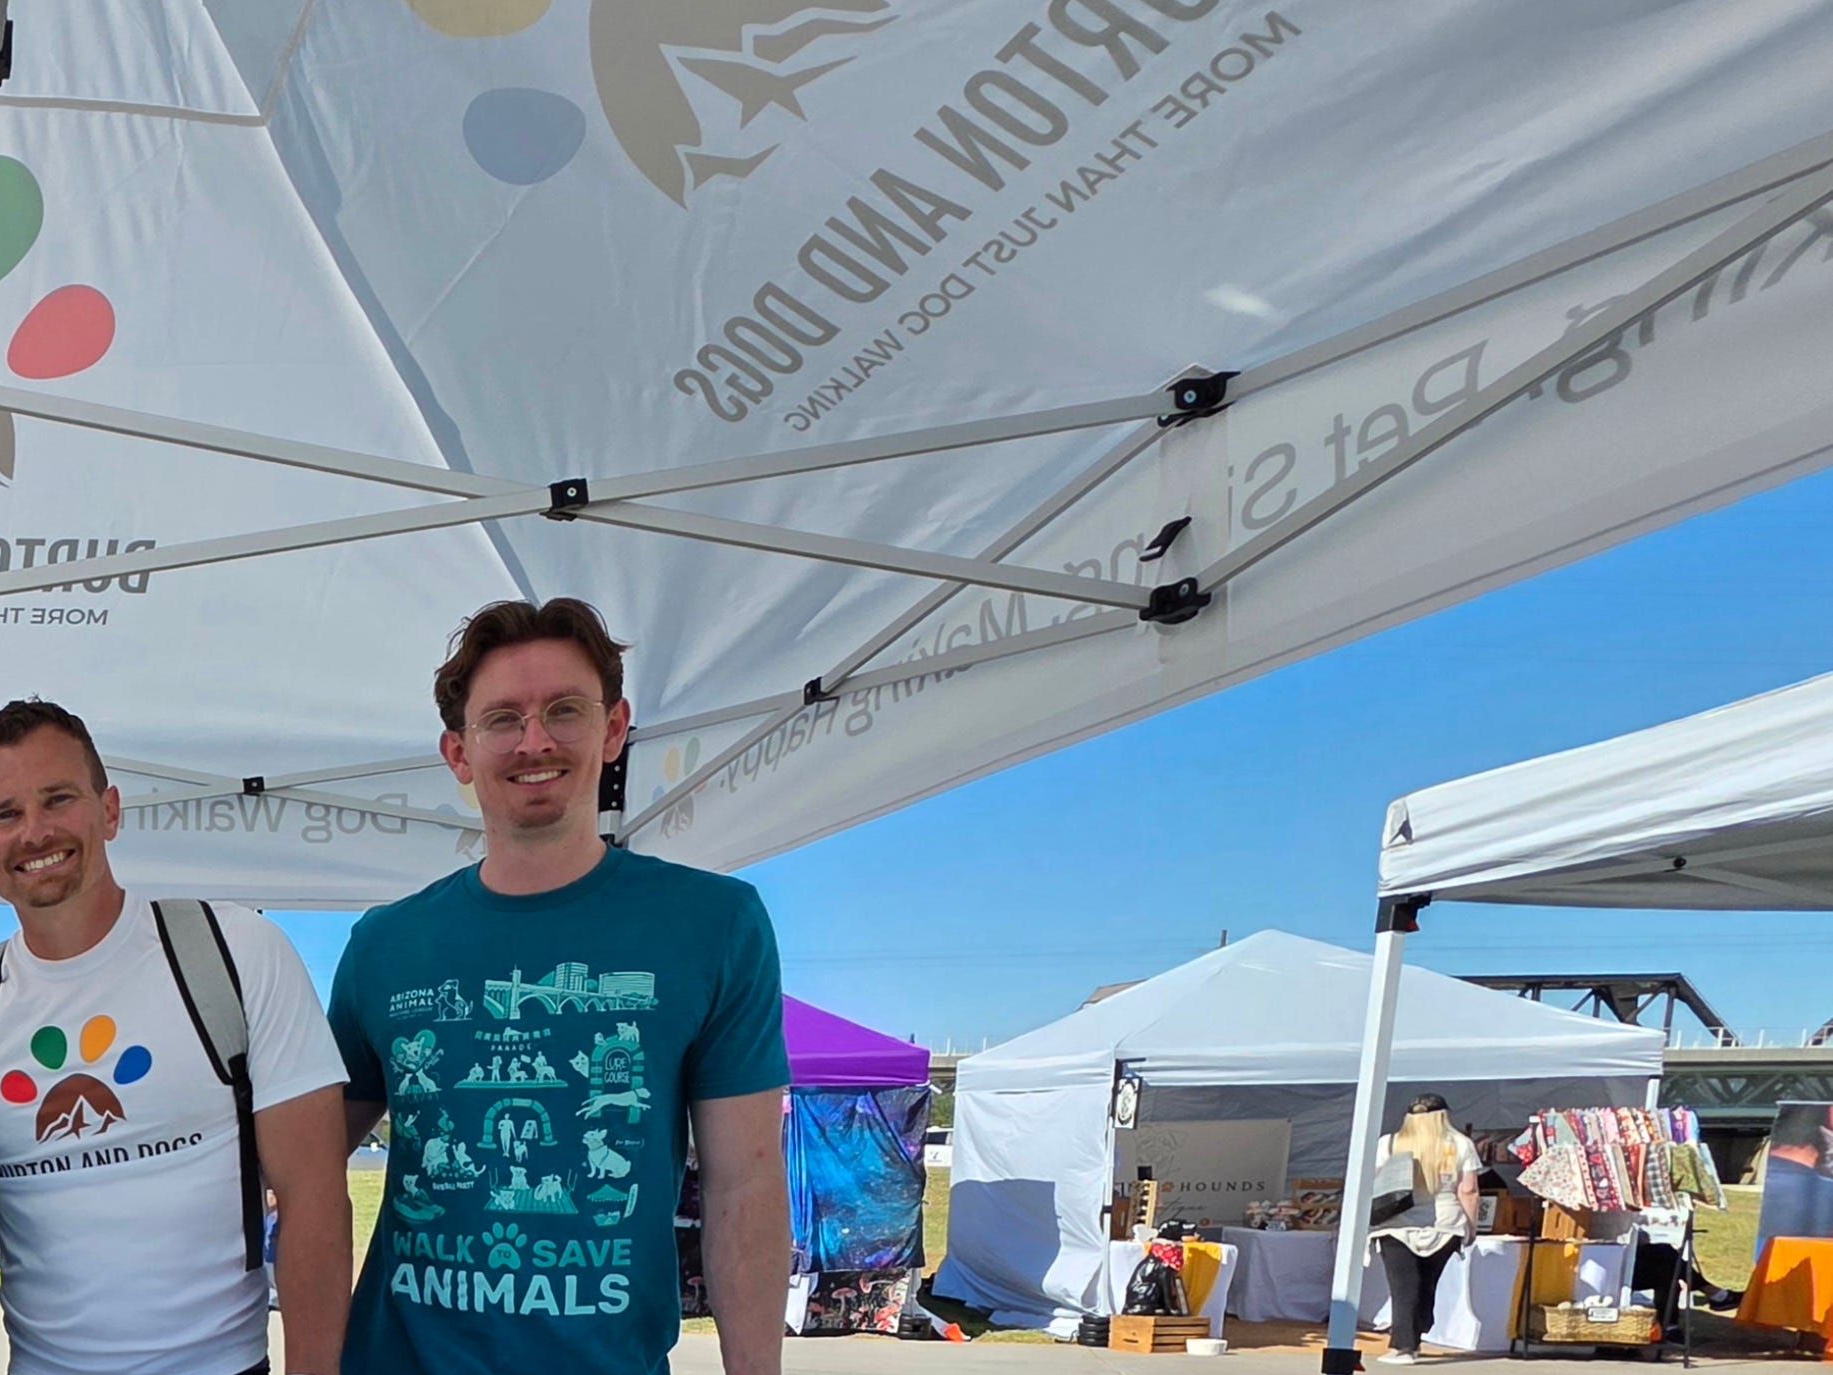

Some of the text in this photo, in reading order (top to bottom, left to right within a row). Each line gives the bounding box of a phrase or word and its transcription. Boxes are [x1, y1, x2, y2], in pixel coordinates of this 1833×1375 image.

[390, 988, 434, 1002] ARIZONA
[389, 998, 433, 1012] ANIMAL
[1180, 1180, 1266, 1192] HOUNDS
[393, 1231, 633, 1268] WALK TO SAVE
[390, 1263, 631, 1316] ANIMALS
